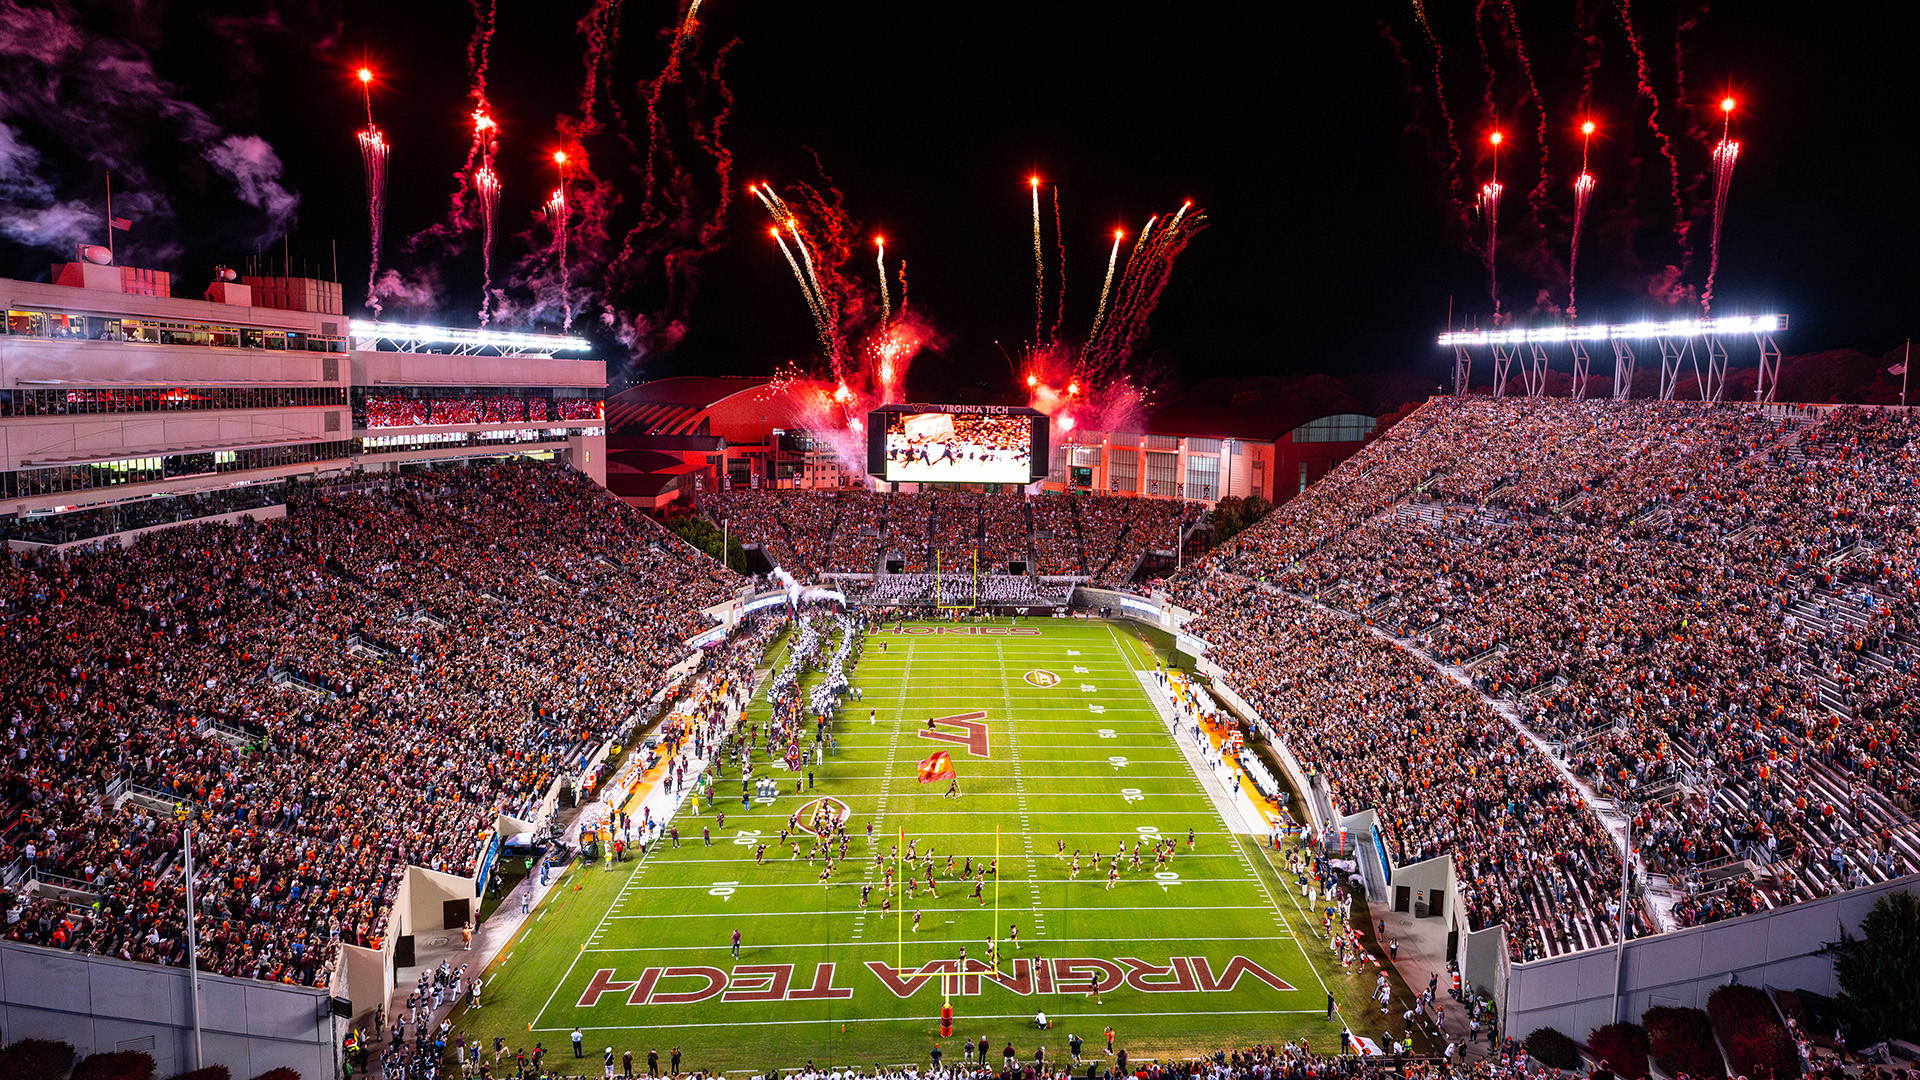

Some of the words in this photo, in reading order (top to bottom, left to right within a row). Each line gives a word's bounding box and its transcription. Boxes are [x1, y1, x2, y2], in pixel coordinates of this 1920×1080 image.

[911, 403, 930, 413] VT
[939, 405, 983, 414] VIRGINIA
[985, 406, 1009, 414] TECH
[868, 626, 1043, 636] HOKIES
[917, 710, 991, 758] VT
[1108, 756, 1129, 767] 40
[1121, 788, 1144, 801] 30
[733, 829, 762, 845] 20
[1136, 826, 1163, 841] 20
[1154, 872, 1182, 886] 10
[708, 880, 739, 896] 10
[863, 955, 1299, 999] VIRGINIA
[575, 962, 854, 1007] TECH
